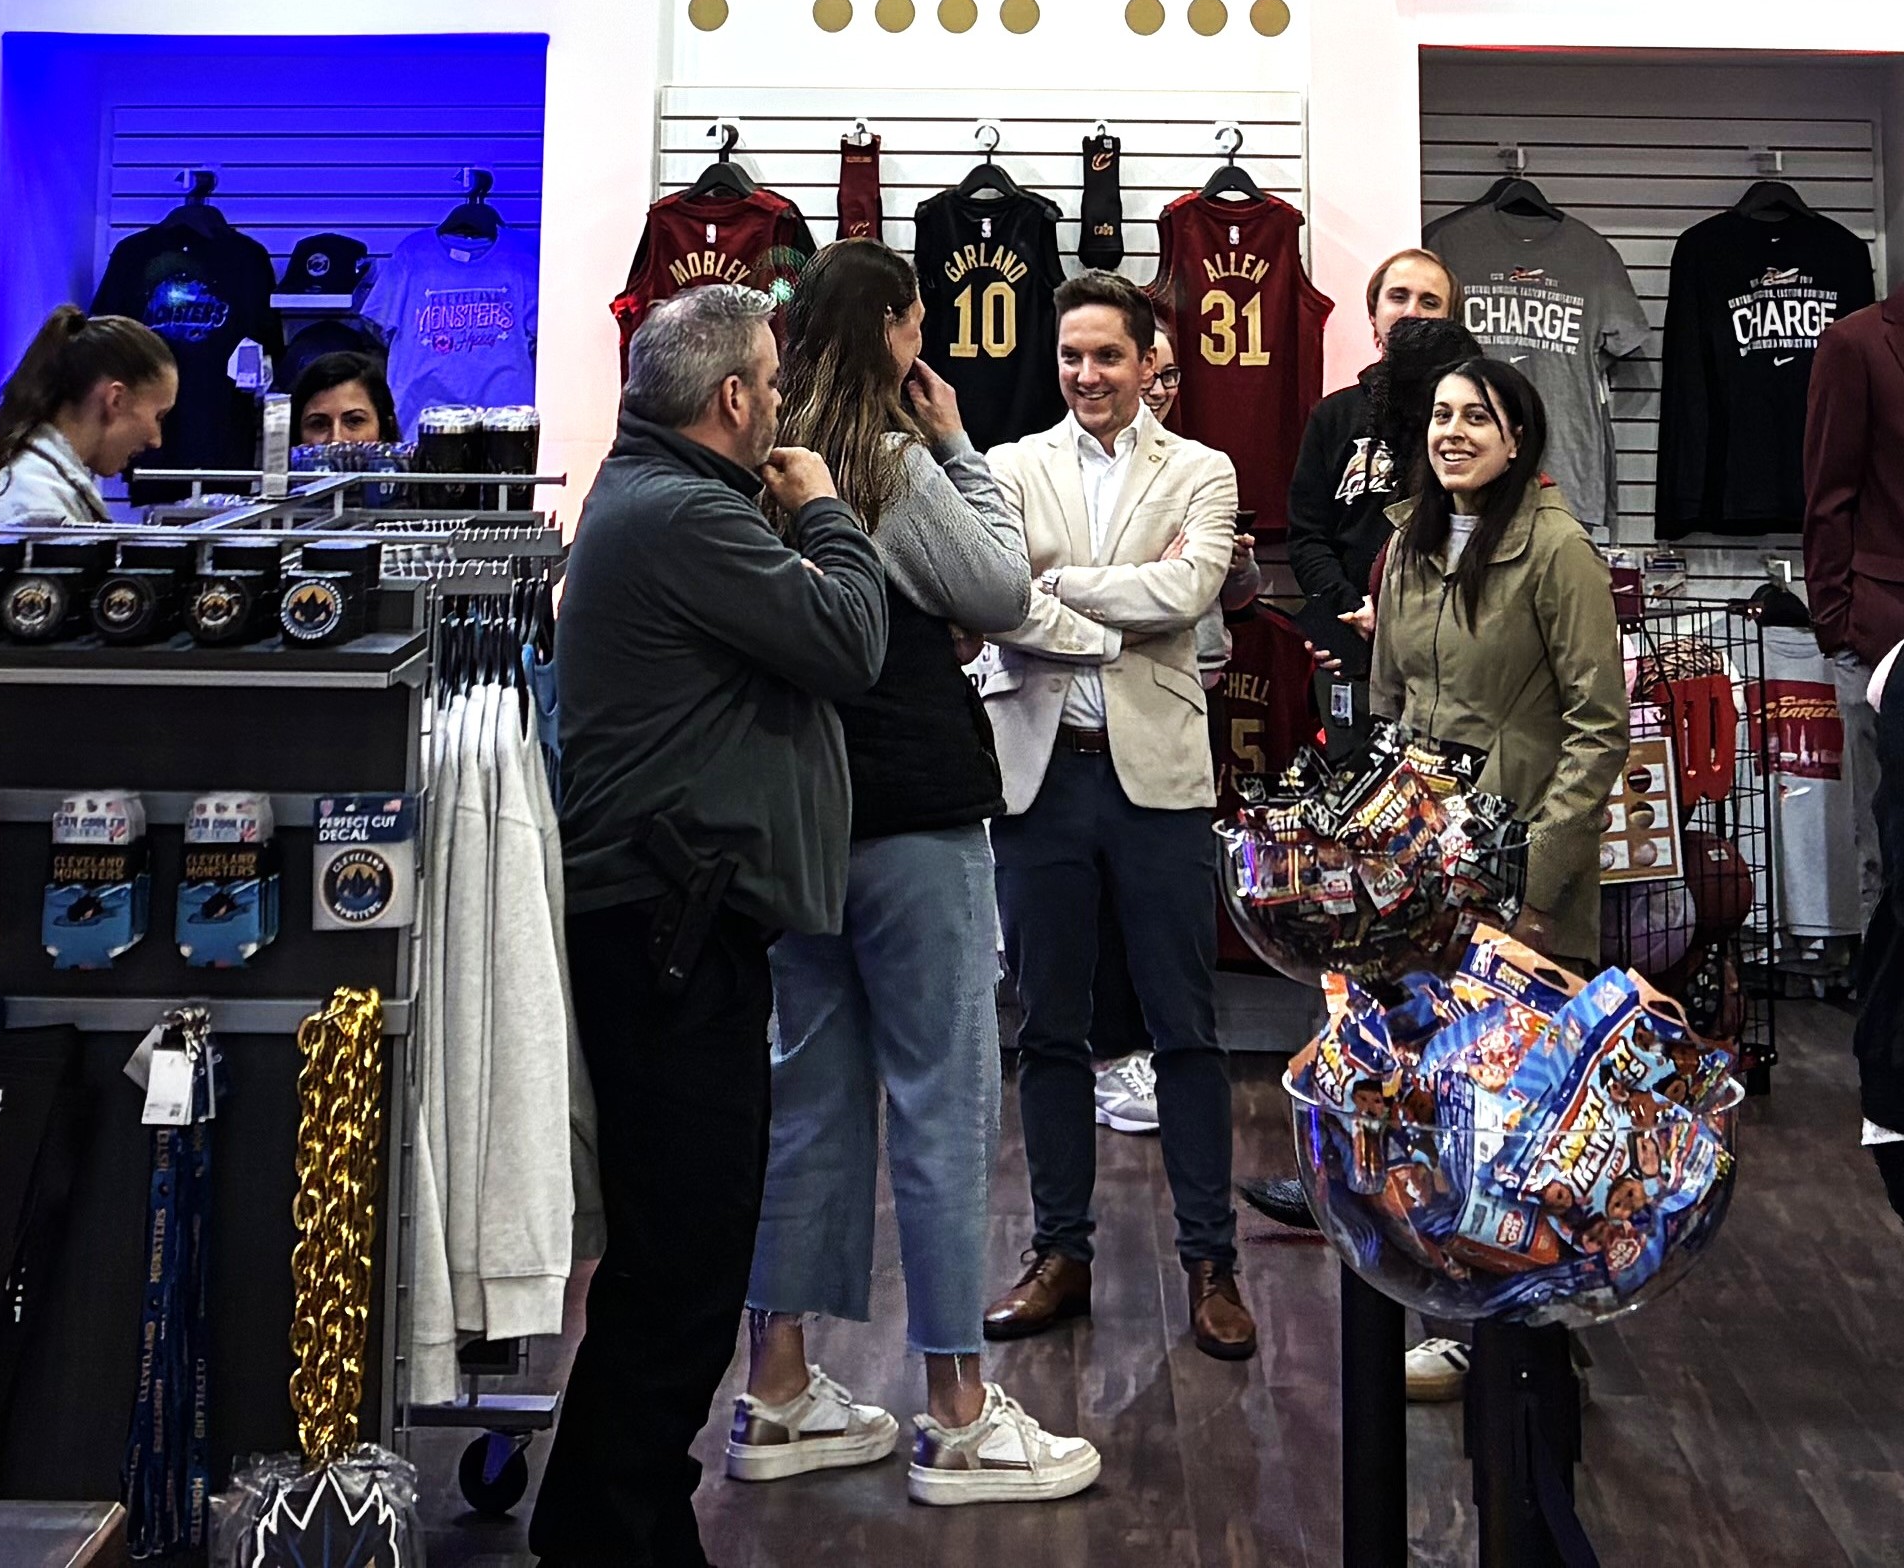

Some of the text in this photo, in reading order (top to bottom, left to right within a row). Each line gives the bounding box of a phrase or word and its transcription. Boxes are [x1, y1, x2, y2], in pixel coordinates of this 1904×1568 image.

[669, 250, 752, 286] MOBLEY
[944, 242, 1028, 283] GARLAND
[1202, 251, 1270, 284] ALLEN
[416, 300, 515, 332] MONSTERS
[949, 281, 1016, 358] 10
[1200, 289, 1270, 366] 31
[1464, 297, 1583, 344] CHARGE
[1732, 300, 1837, 344] CHARGE
[1224, 672, 1270, 706] HELL
[319, 829, 370, 842] DECAL
[371, 814, 398, 828] CUT
[53, 855, 125, 869] CLEVELAND
[53, 868, 124, 882] MONSTERS
[185, 852, 257, 866] CLEVELAND
[185, 865, 257, 878] MONSTERS
[331, 851, 385, 873] CLEVELAND
